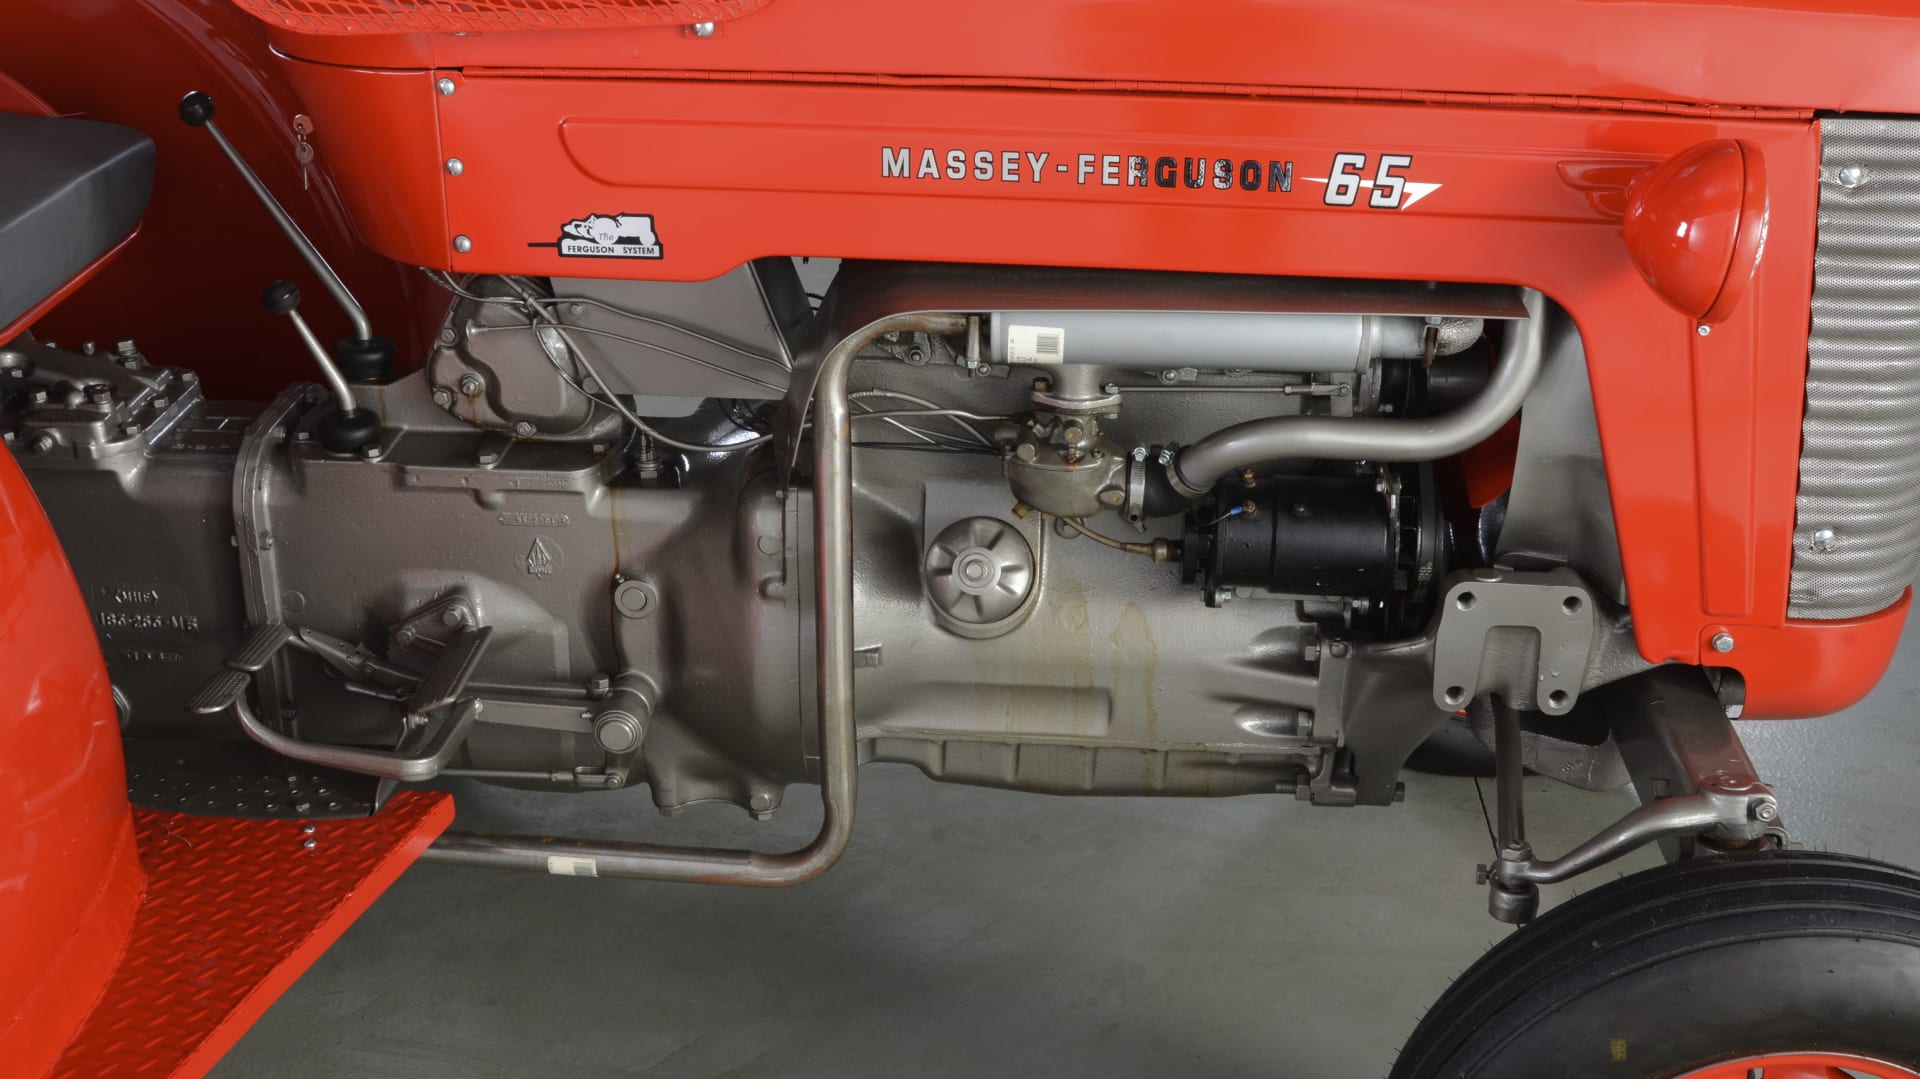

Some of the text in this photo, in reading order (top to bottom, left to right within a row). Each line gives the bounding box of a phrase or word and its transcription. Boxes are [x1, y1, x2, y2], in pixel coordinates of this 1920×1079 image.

[881, 146, 1413, 209] MASSEY-FERGUSON 65
[599, 232, 614, 242] The
[567, 245, 655, 255] FERGUSON SYSTEM
